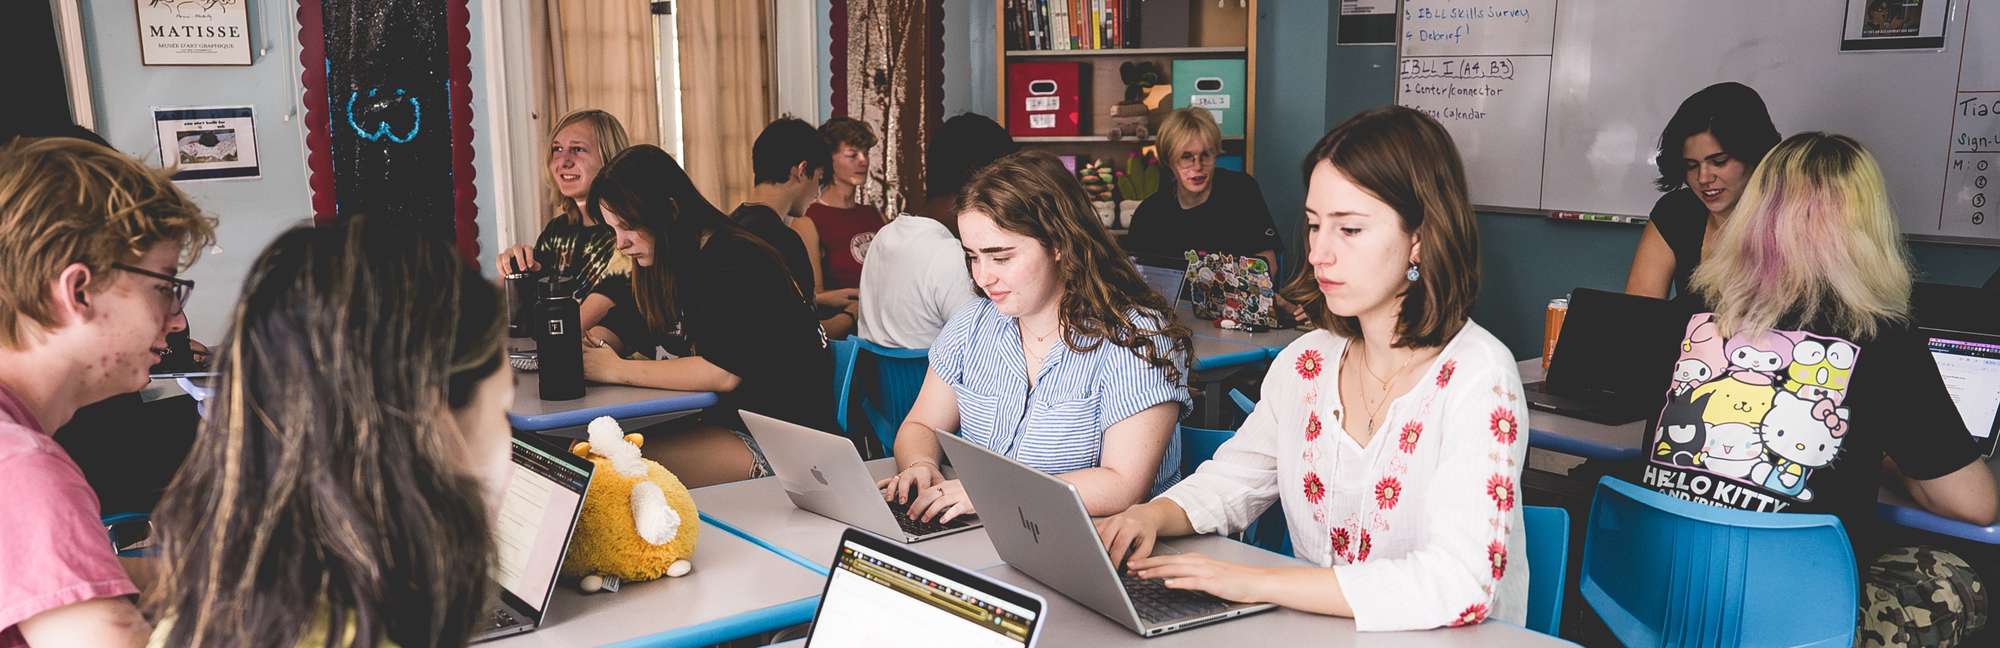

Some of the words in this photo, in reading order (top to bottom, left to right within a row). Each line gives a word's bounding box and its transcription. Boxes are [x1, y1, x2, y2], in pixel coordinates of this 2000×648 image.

[1450, 7, 1486, 19] Skills
[1487, 6, 1530, 23] Survey
[150, 25, 240, 38] MATISSE
[1401, 59, 1437, 75] IBLL
[1443, 60, 1454, 75] I
[1490, 58, 1514, 80] B3)
[1443, 106, 1487, 120] Calendar
[1643, 465, 1712, 495] HELLO
[1713, 481, 1786, 512] KITTY
